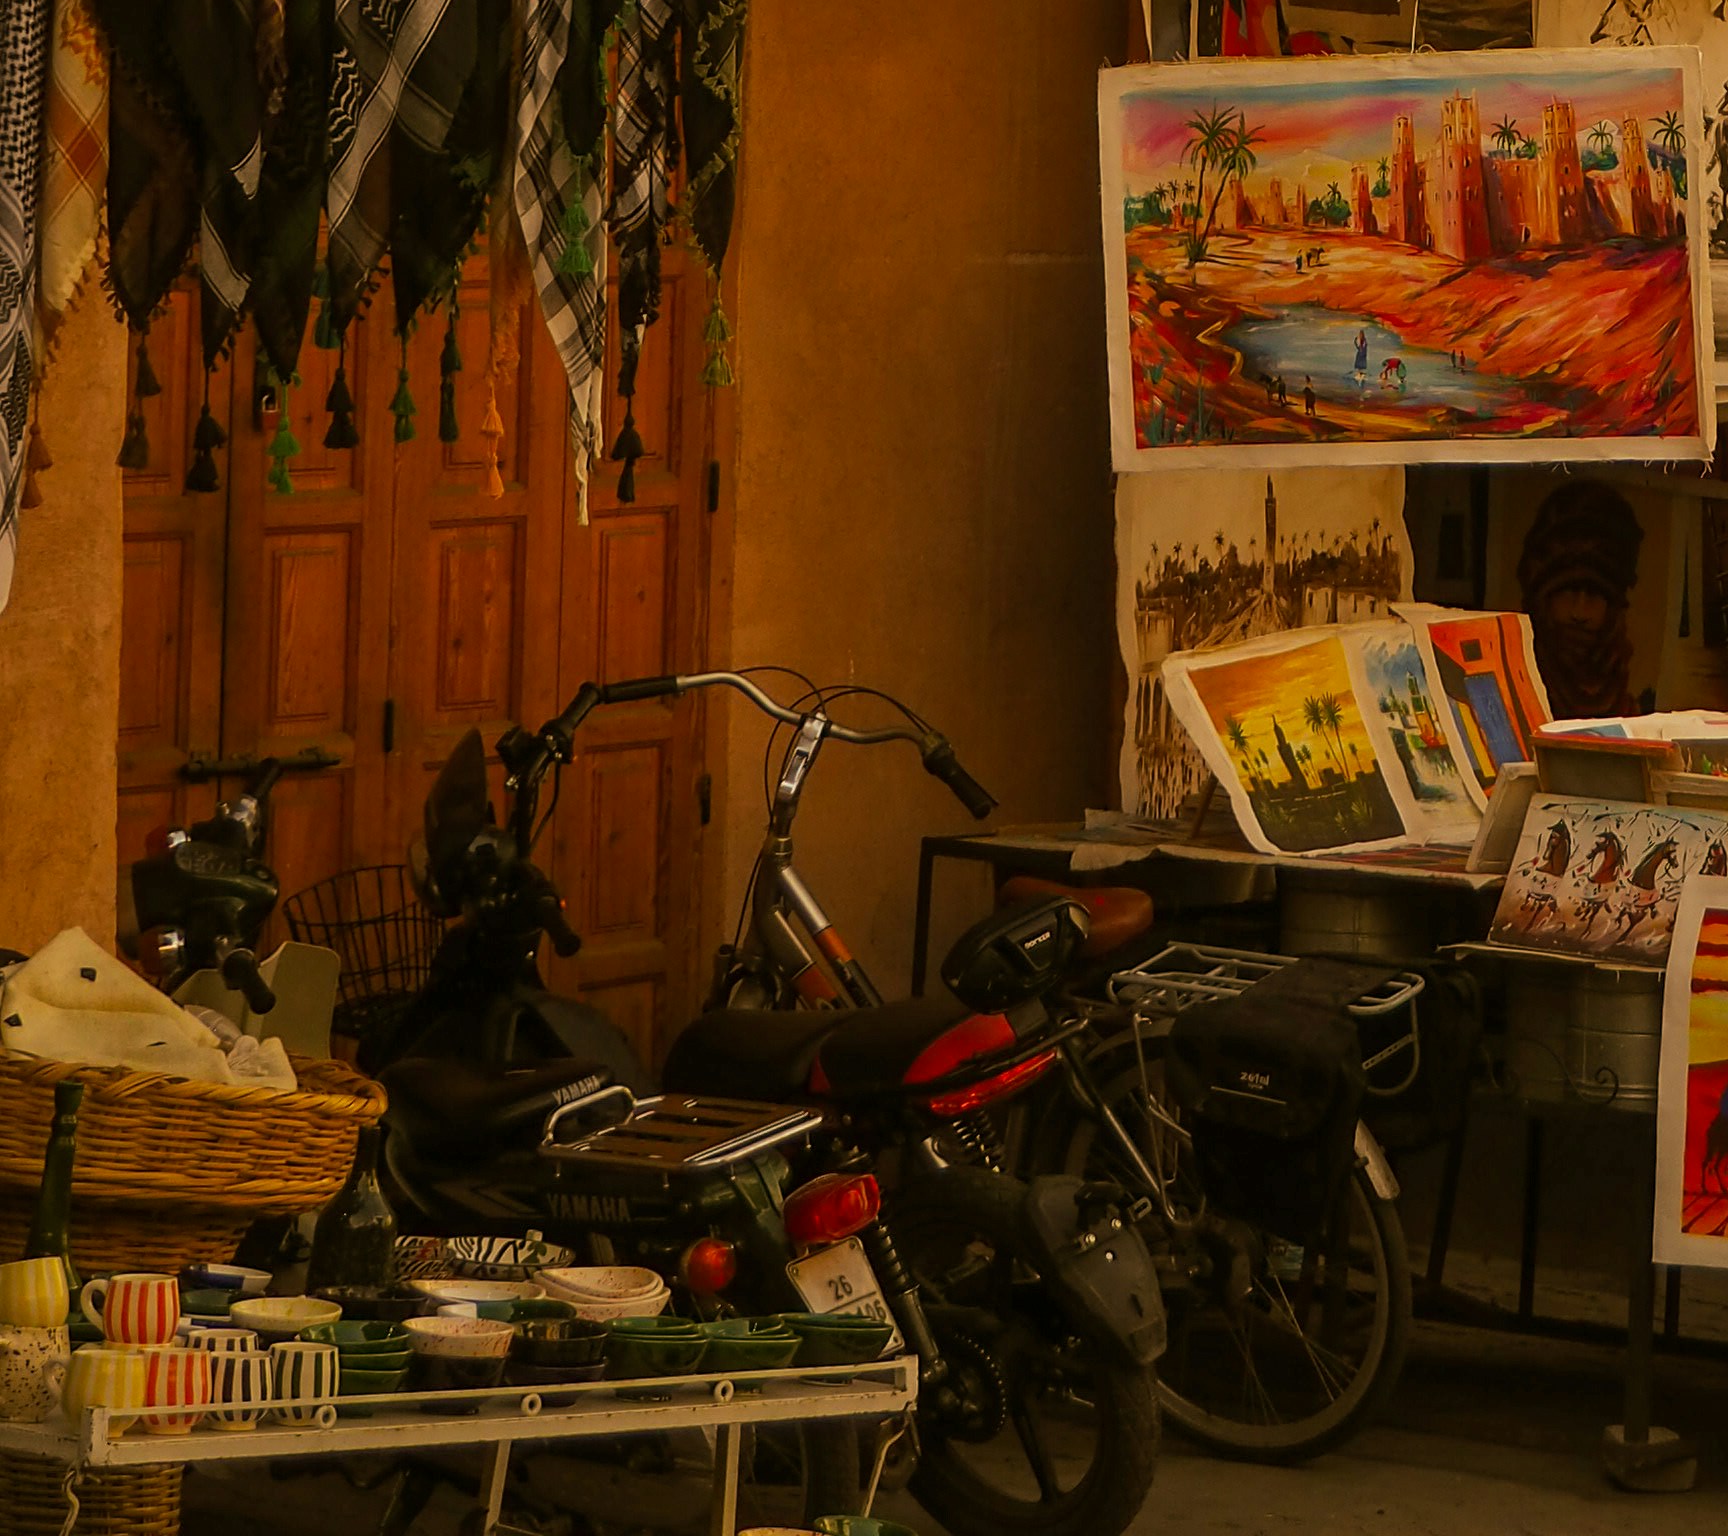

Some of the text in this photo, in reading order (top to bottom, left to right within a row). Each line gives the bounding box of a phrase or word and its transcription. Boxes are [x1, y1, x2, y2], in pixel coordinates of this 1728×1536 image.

[551, 1074, 601, 1106] YAMAHA
[547, 1192, 632, 1222] YAMAHA
[828, 1274, 853, 1302] 26
